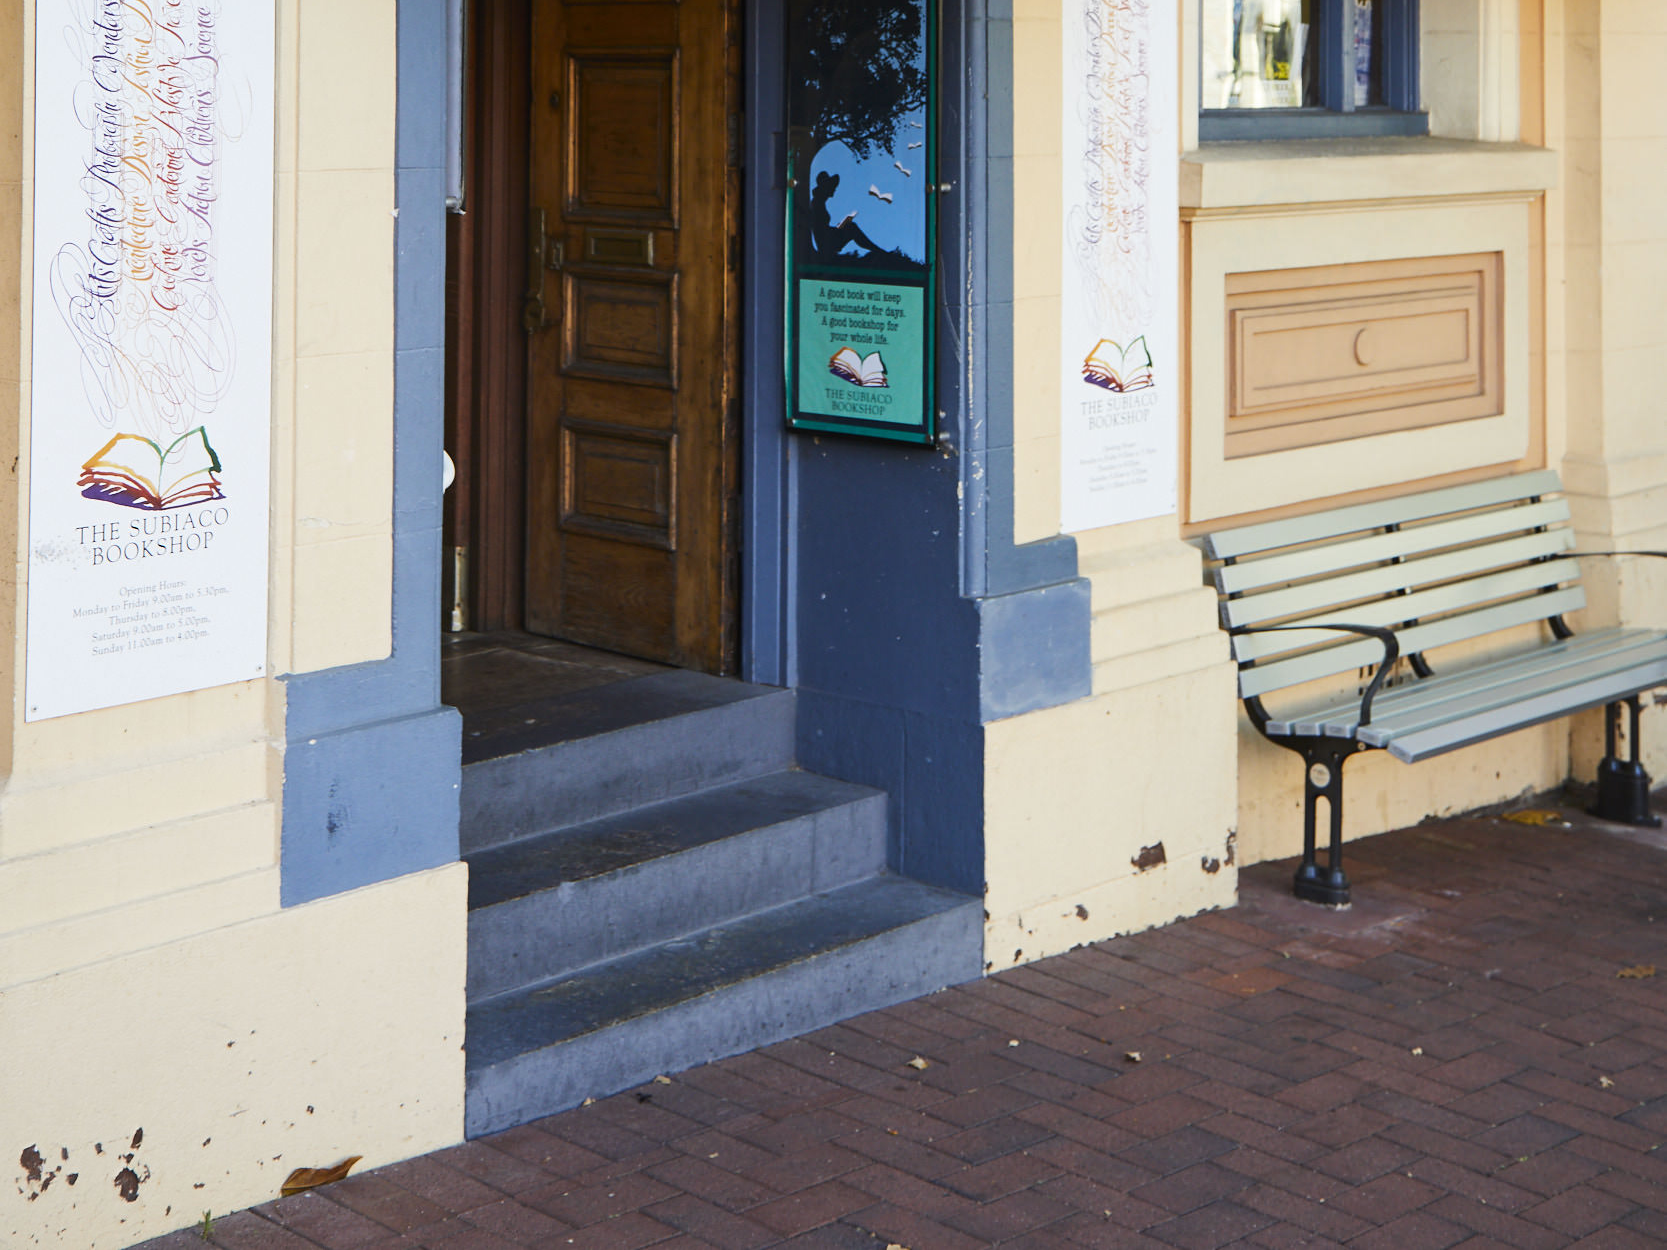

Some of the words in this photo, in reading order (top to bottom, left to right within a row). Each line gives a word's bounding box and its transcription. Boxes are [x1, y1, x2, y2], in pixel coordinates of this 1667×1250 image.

[92, 0, 126, 93] Calendars
[183, 7, 218, 76] Science
[121, 116, 154, 191] Design
[819, 286, 825, 297] A
[827, 289, 845, 300] good
[847, 289, 865, 300] book
[867, 291, 881, 301] will
[883, 291, 901, 305] keep
[814, 303, 828, 313] you
[830, 302, 870, 315] fascinated
[872, 305, 883, 315] for
[821, 315, 827, 325] A
[829, 318, 847, 328] good
[849, 318, 885, 332] bookshop
[887, 321, 899, 332] for
[830, 332, 848, 342] your
[850, 332, 873, 344] whole
[825, 388, 844, 399] THE
[847, 390, 893, 404] SUBIACO
[1080, 400, 1103, 416] THE
[1107, 392, 1158, 412] SUBIACO
[832, 400, 886, 415] BOOKSHOP
[75, 522, 120, 545] THE
[129, 507, 229, 538] SUBIACO
[92, 531, 214, 566] BOOKSHOP
[119, 584, 157, 598] Opening
[72, 605, 109, 618] Monday
[111, 603, 121, 612] to
[123, 597, 151, 610] Friday
[185, 591, 194, 600] to
[109, 613, 149, 626] Thursday
[151, 611, 161, 620] to
[91, 628, 131, 643] Saturday
[167, 621, 176, 629] to
[91, 642, 125, 656] Sunday
[166, 634, 175, 643] to
